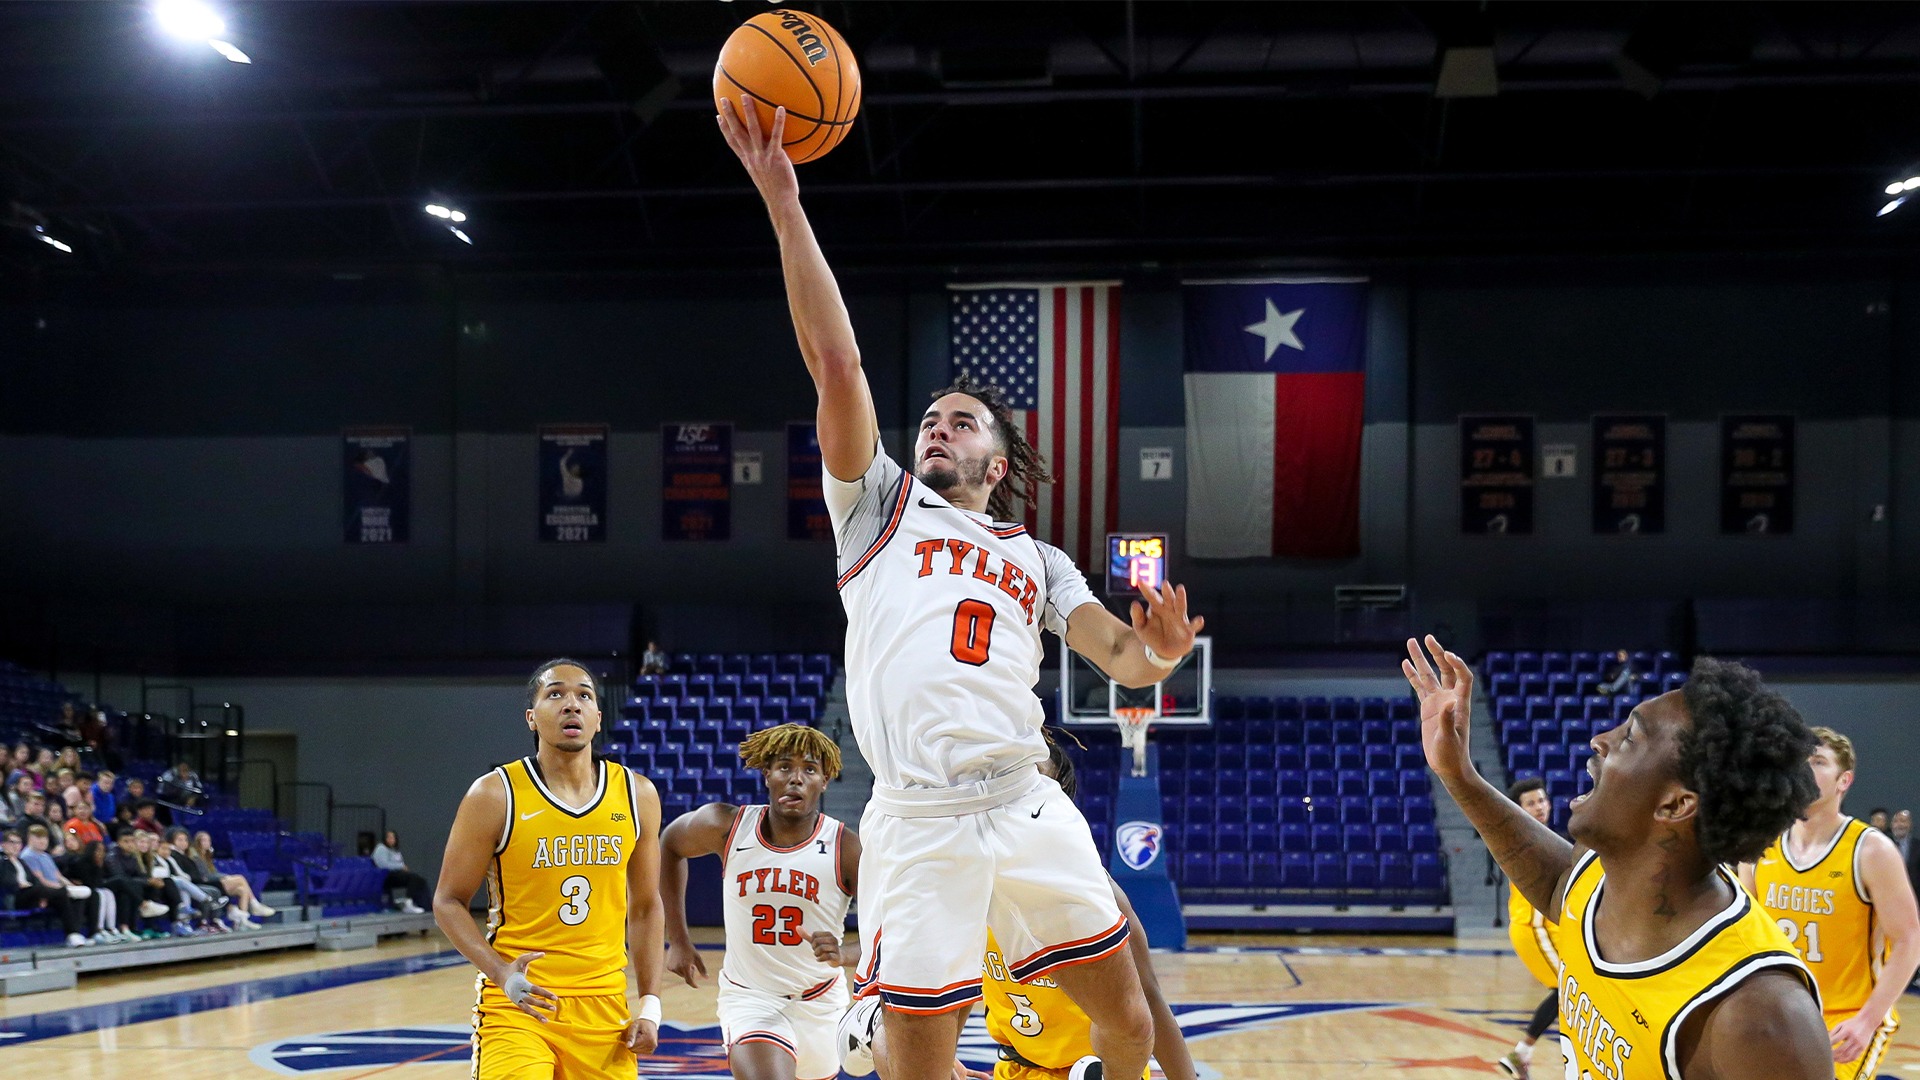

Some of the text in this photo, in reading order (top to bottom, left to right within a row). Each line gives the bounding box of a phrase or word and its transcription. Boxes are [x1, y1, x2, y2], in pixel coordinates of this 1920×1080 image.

[768, 9, 828, 68] Wilso
[1153, 462, 1160, 478] 7
[557, 527, 589, 541] 2021
[914, 538, 1038, 626] TYLER
[1130, 557, 1157, 588] 13
[950, 598, 997, 667] 0
[532, 834, 622, 869] AGGIES
[558, 875, 592, 926] 3
[736, 868, 820, 905] TYLER
[1765, 882, 1835, 916] AGGIES
[752, 904, 804, 946] 23
[1005, 992, 1044, 1037] 5
